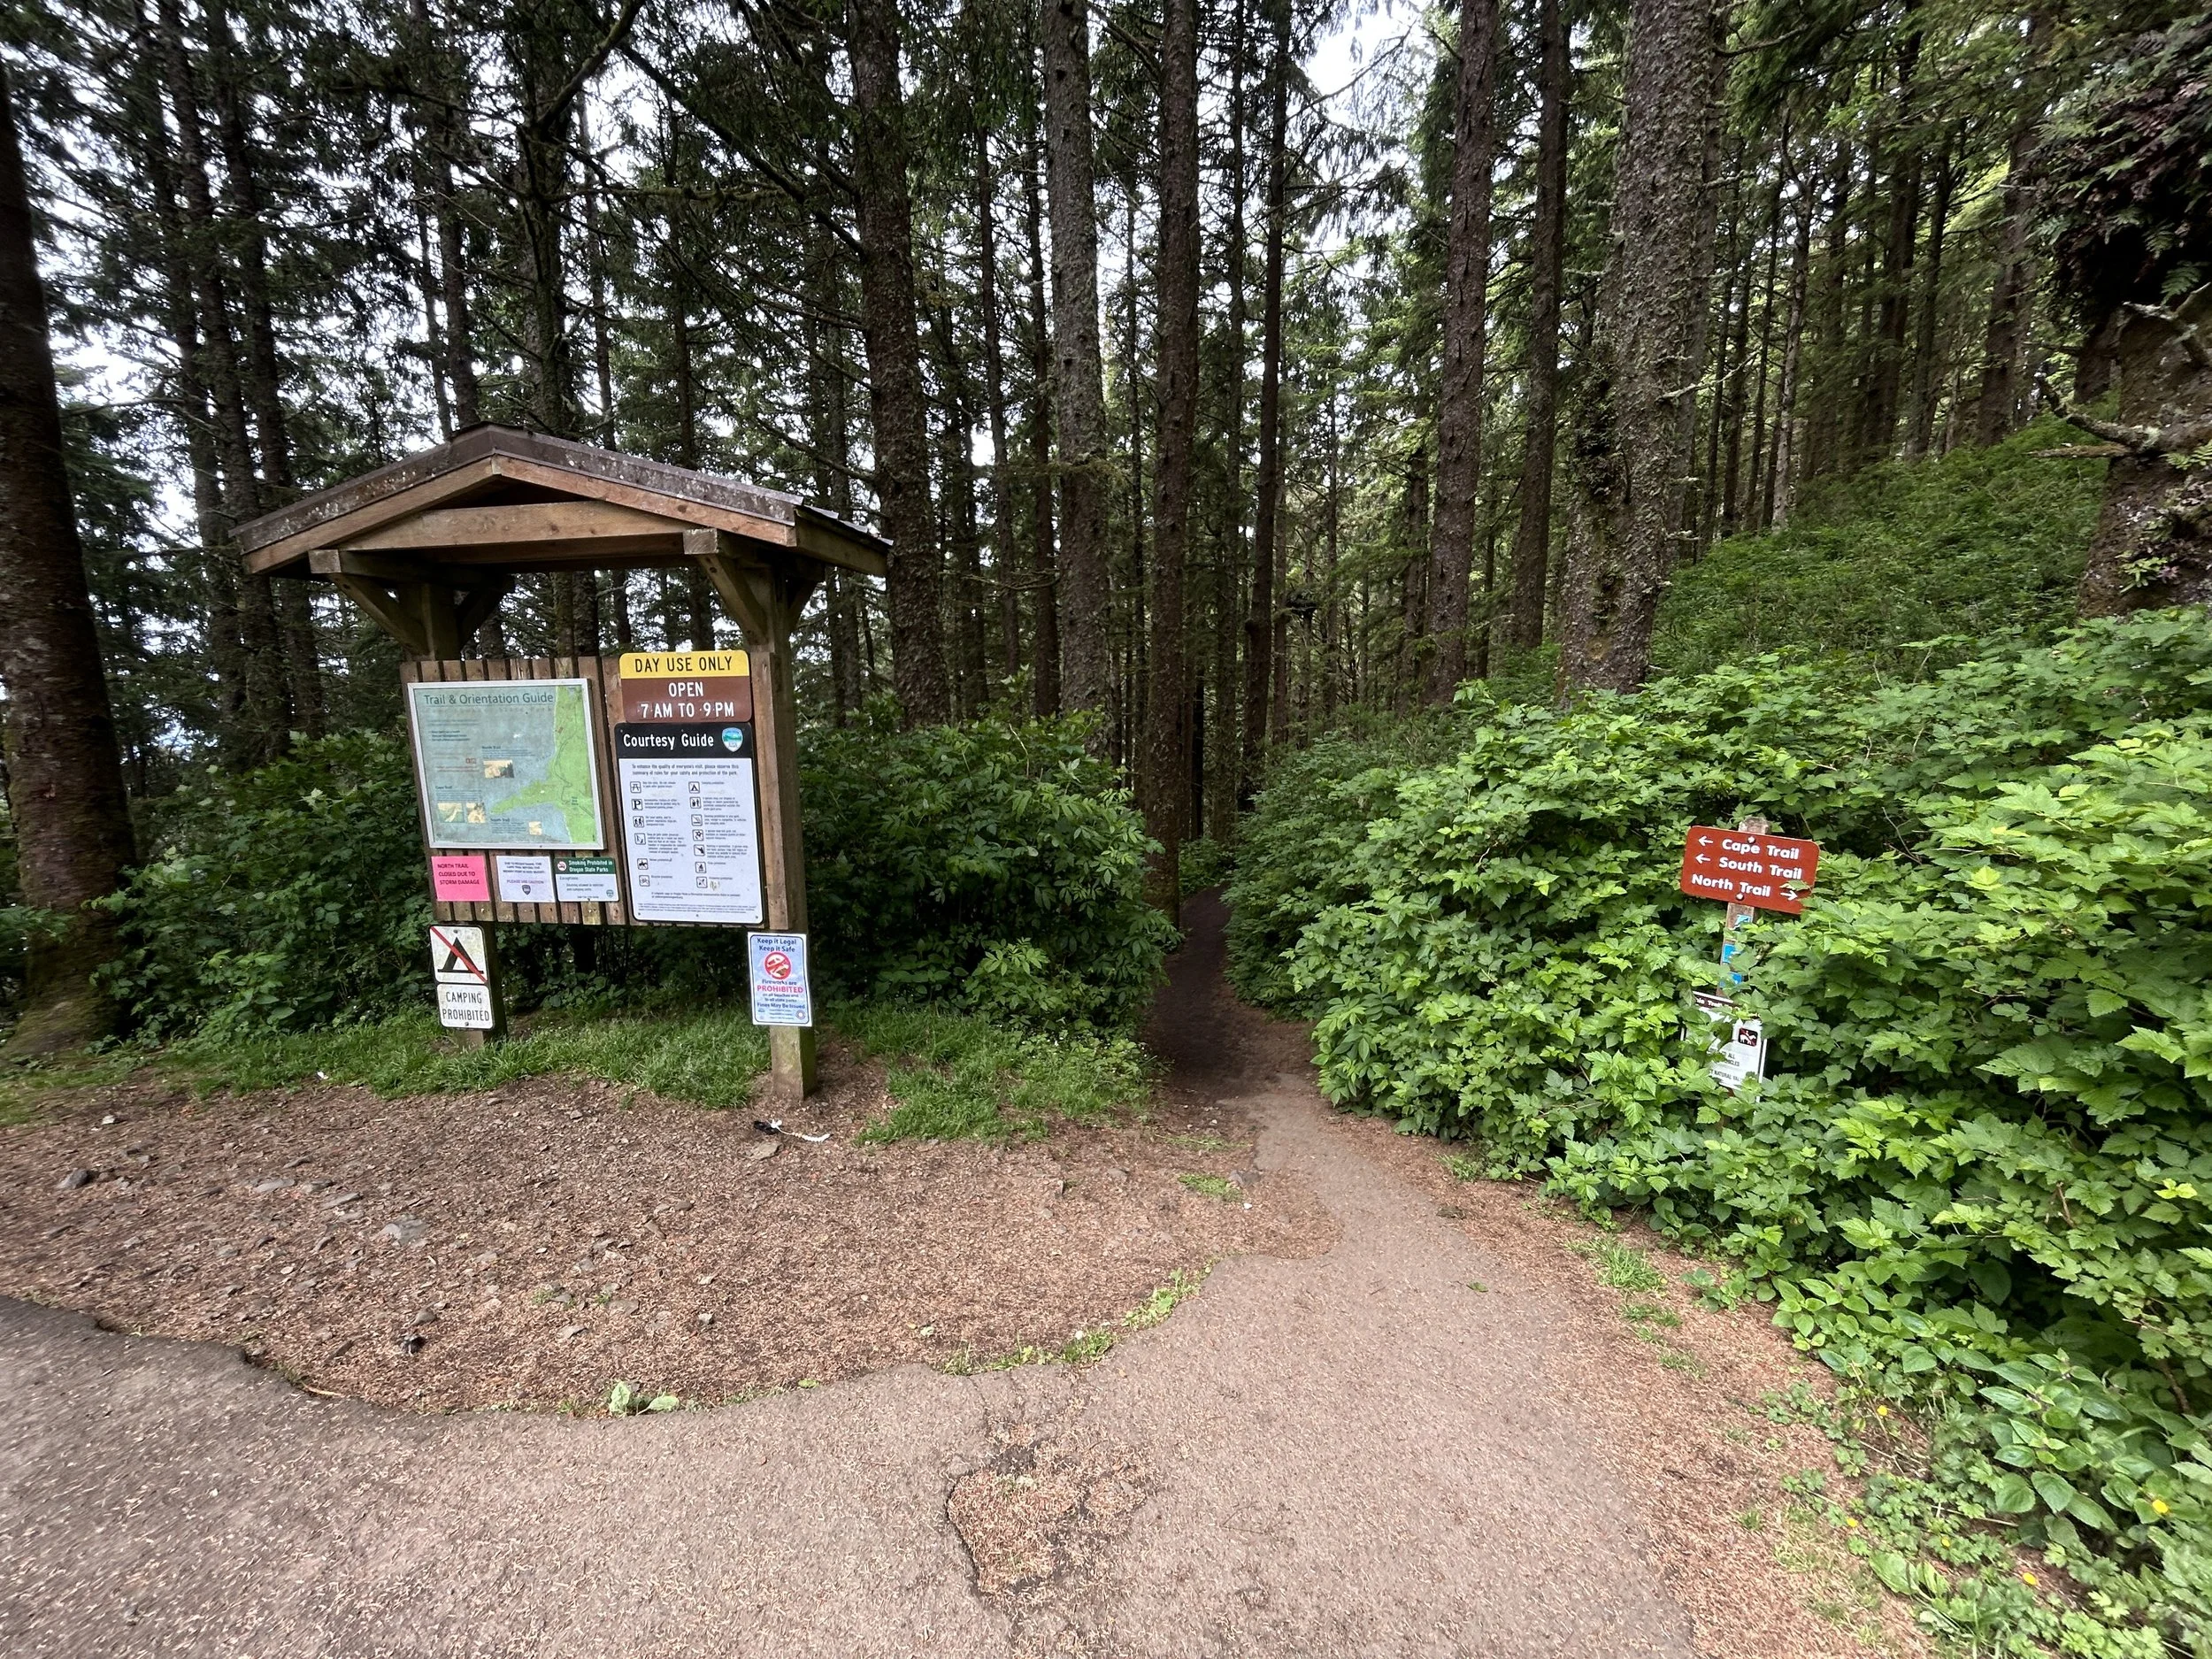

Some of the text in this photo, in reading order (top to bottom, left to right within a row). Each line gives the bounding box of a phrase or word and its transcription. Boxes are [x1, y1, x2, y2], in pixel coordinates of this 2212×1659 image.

[635, 657, 733, 672] DAY USE ONLY
[668, 682, 703, 697] OPEN
[424, 693, 554, 705] Trail & Orientation Guide
[641, 702, 734, 718] 7 AM TO 9 PM
[623, 733, 675, 750] Courtesy
[681, 733, 714, 747] Guide
[1722, 839, 1800, 860] Cape Trail
[1719, 857, 1802, 879] South Trail
[1692, 874, 1770, 897] North Trail
[446, 992, 482, 1003] CAMPING
[442, 1009, 489, 1021] PROHIBITED
